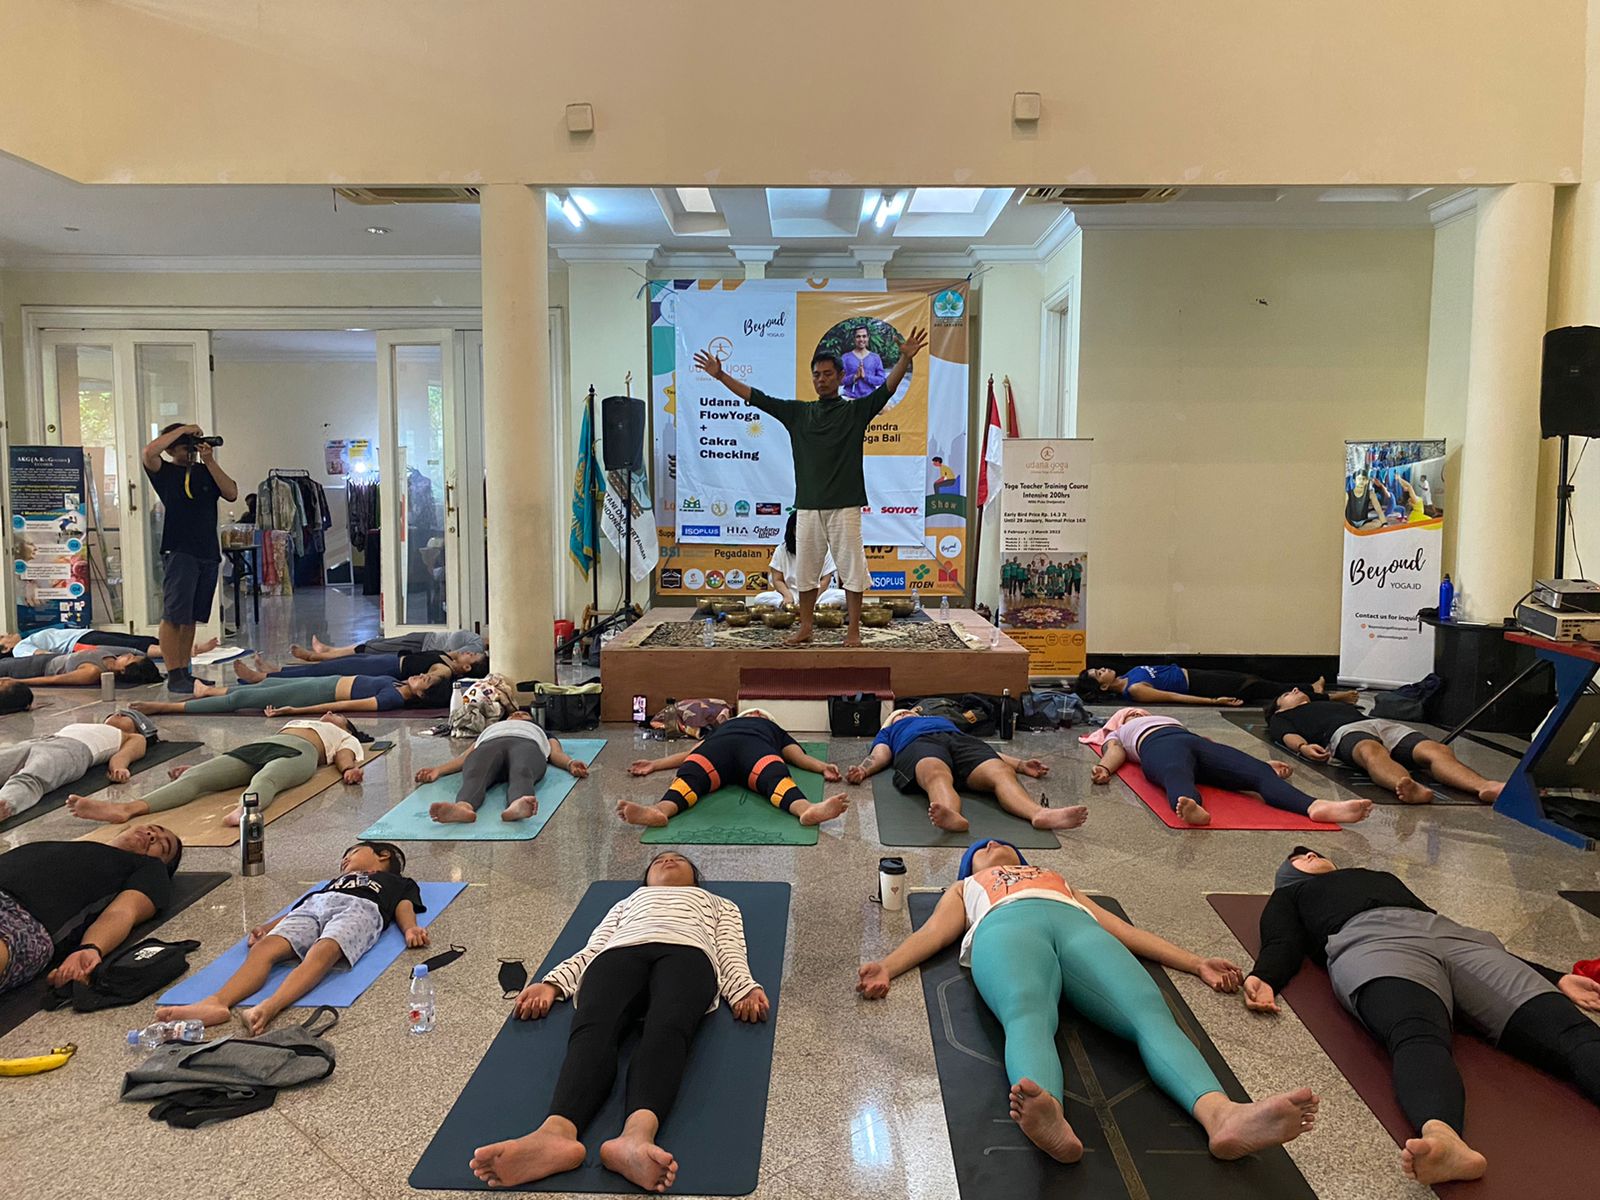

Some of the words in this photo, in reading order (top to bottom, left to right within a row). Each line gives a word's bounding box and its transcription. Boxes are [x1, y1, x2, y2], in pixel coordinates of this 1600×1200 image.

[744, 311, 786, 337] Beyond
[699, 397, 740, 407] Udana
[699, 410, 760, 422] FlowYoga
[866, 423, 899, 433] jendra
[699, 436, 737, 446] Cakra
[862, 434, 880, 444] oga
[882, 433, 901, 443] Bali
[699, 449, 760, 462] Checking
[1004, 482, 1019, 491] Yoga
[1044, 482, 1068, 491] Training
[1050, 491, 1070, 499] 200hrs
[931, 500, 957, 509] Show
[604, 505, 627, 539] NDONESIA
[684, 527, 719, 535] ISOPLUS
[714, 549, 762, 559] Pegadaian
[1349, 547, 1427, 589] Beyond
[1355, 612, 1379, 620] Contact
